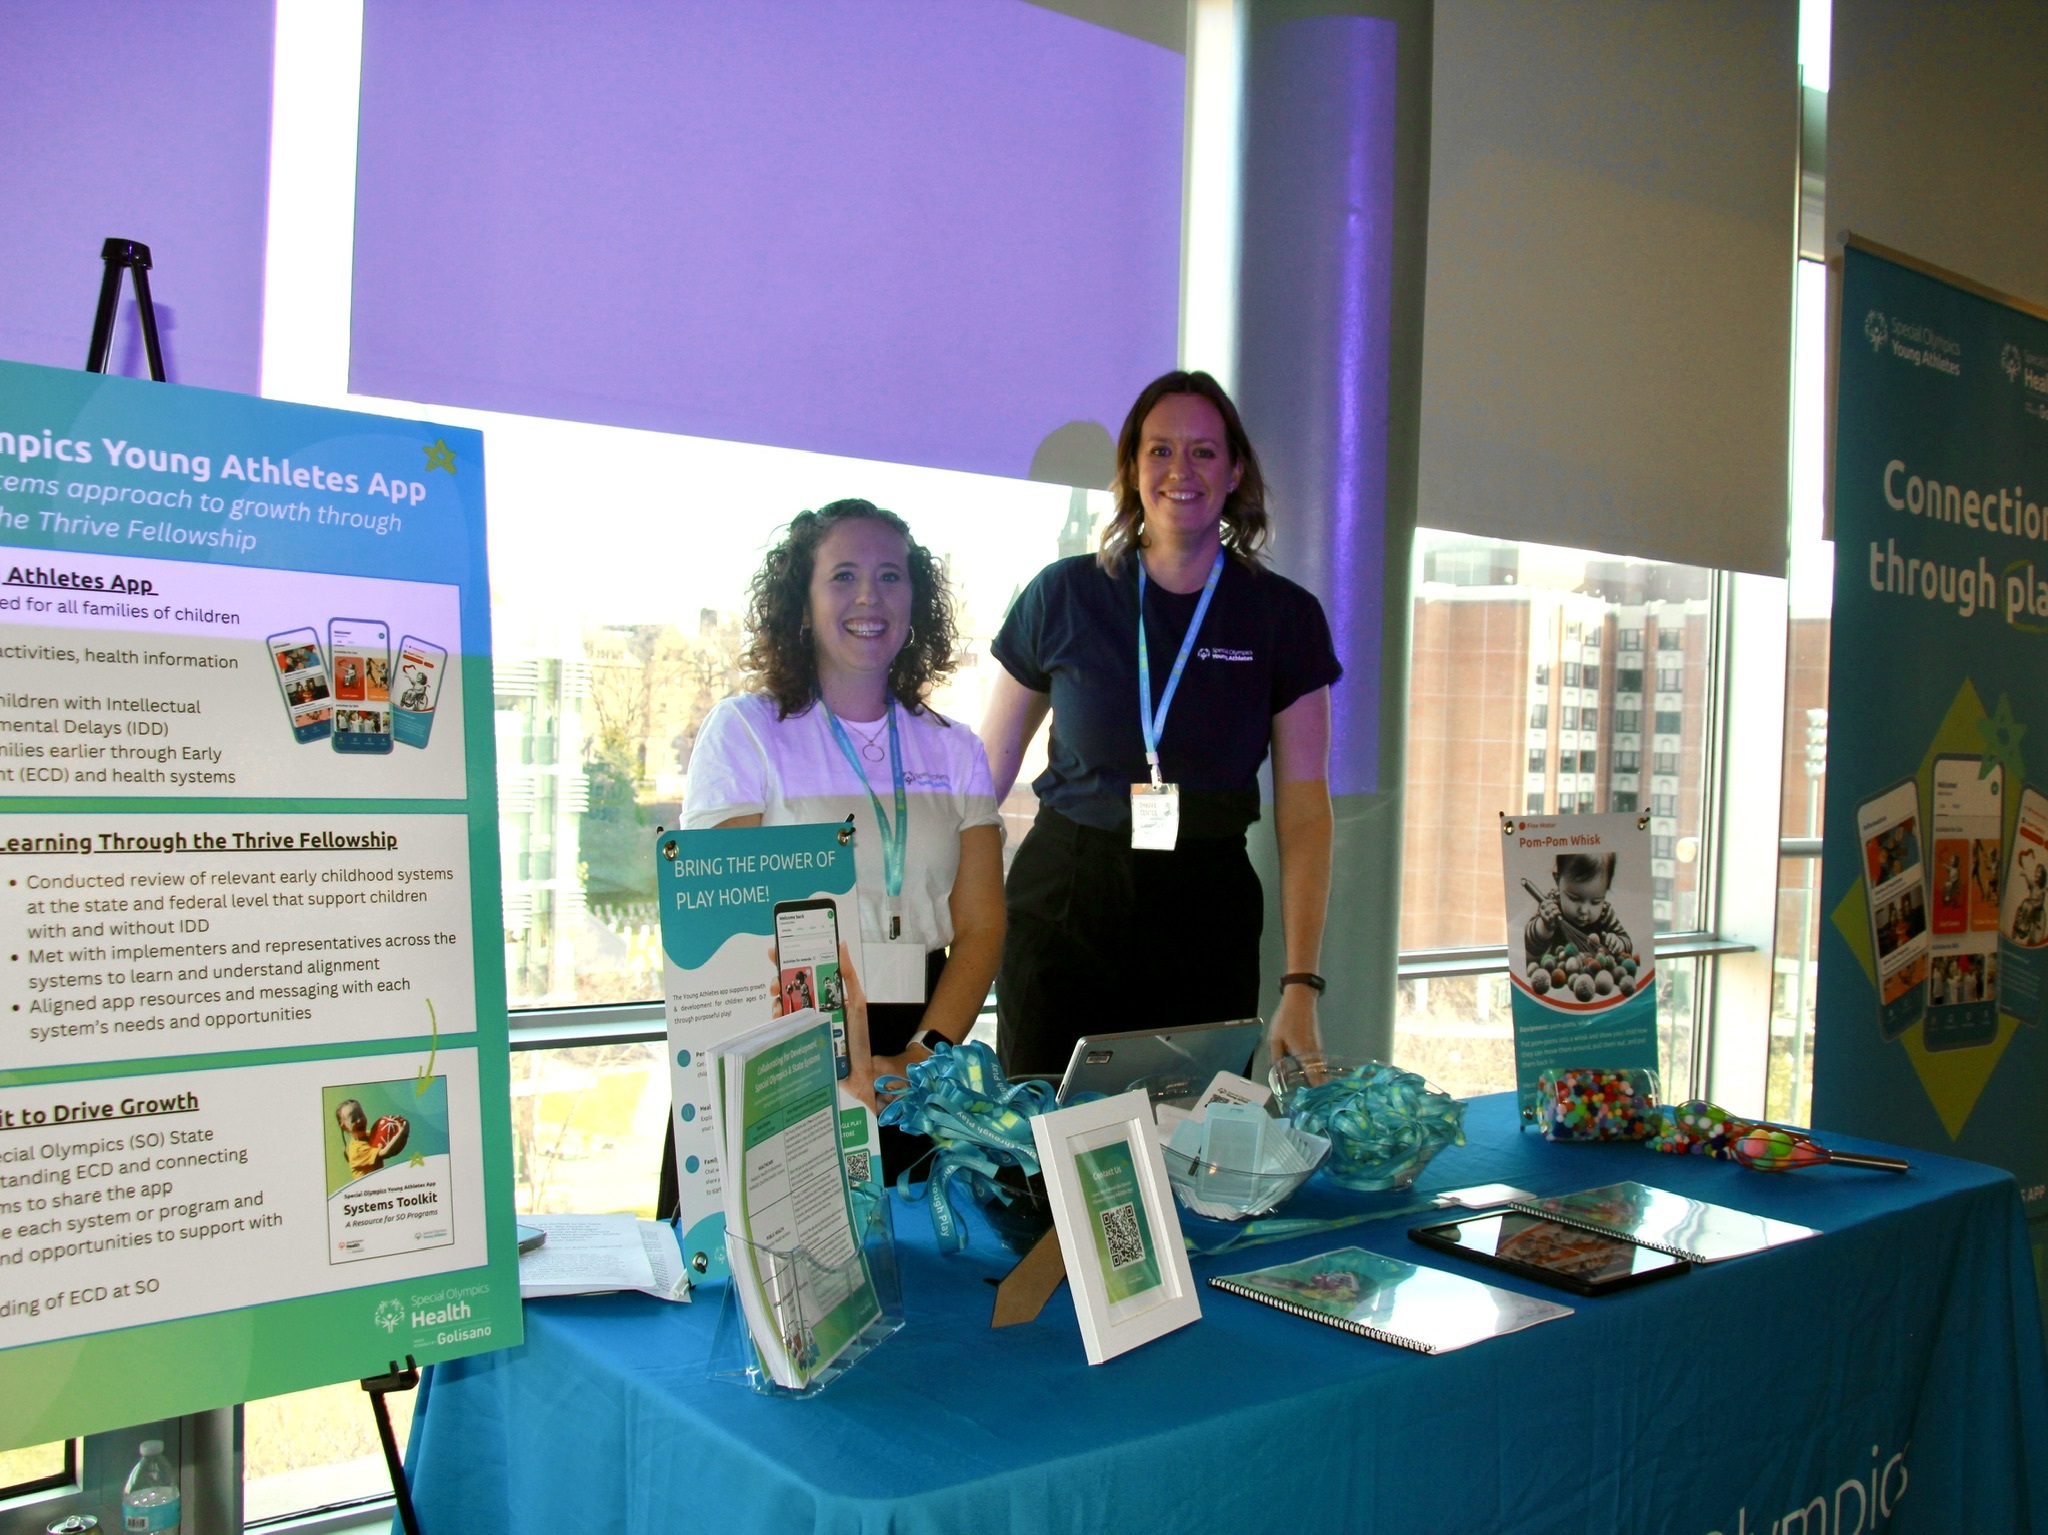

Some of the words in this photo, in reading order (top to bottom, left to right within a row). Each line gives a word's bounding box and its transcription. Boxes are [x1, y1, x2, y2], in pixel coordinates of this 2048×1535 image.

[1891, 339, 1921, 366] Young
[1922, 349, 1961, 376] Athletes
[101, 438, 212, 483] Young
[219, 453, 360, 494] Athletes
[367, 471, 427, 507] App
[66, 482, 193, 509] approach
[199, 493, 225, 514] to
[228, 498, 311, 523] growth
[317, 504, 402, 533] through
[38, 510, 121, 539] Thrive
[126, 519, 257, 554] Fellowship
[7, 566, 105, 589] Athletes
[110, 574, 153, 596] App
[1869, 538, 1996, 617] through
[24, 596, 54, 613] for
[56, 599, 79, 615] all
[81, 600, 150, 619] families
[152, 605, 172, 620] of
[173, 606, 241, 625] children
[83, 647, 139, 665] health
[142, 650, 239, 670] information
[62, 695, 102, 711] with
[105, 696, 202, 715] Intellectual
[62, 719, 123, 739] Delays
[126, 720, 169, 738] (IDD)
[48, 743, 107, 759] earlier
[109, 744, 178, 764] through
[181, 746, 223, 765] Early
[18, 766, 70, 784] (ECD)
[73, 767, 108, 783] and
[111, 767, 166, 784] health
[169, 770, 237, 787] systems
[99, 832, 187, 854] Through
[193, 831, 227, 849] the
[232, 831, 295, 849] Thrive
[300, 831, 398, 851] Fellowship
[1519, 836, 1568, 848] Pom-Pom
[1570, 833, 1601, 846] Whisk
[674, 857, 723, 878] BRING
[726, 855, 756, 874] THE
[760, 852, 813, 872] POWER
[816, 850, 836, 868] OF
[25, 872, 126, 890] Conducted
[129, 871, 186, 888] review
[188, 870, 208, 886] of
[210, 870, 277, 886] relevant
[279, 868, 318, 887] early
[320, 867, 394, 883] childhood
[397, 868, 454, 885] systems
[25, 900, 46, 915] at
[49, 898, 81, 914] the
[83, 898, 129, 913] state
[132, 895, 165, 912] and
[168, 893, 228, 910] federal
[231, 892, 270, 909] level
[271, 892, 305, 907] that
[307, 891, 367, 909] support
[369, 889, 428, 904] children
[676, 889, 715, 910] PLAY
[719, 885, 770, 906] HOME!
[26, 923, 67, 940] with
[70, 921, 105, 938] and
[108, 920, 176, 937] without
[178, 918, 210, 934] IDD
[27, 948, 65, 964] Met
[67, 945, 107, 963] with
[110, 943, 228, 963] implementers
[230, 938, 261, 955] and
[264, 934, 383, 956] representatives
[384, 934, 431, 948] across
[432, 931, 457, 946] the
[27, 973, 104, 993] systems
[106, 971, 126, 985] to
[129, 968, 174, 984] learn
[176, 964, 209, 982] and
[212, 959, 304, 980] understand
[306, 957, 381, 977] alignment
[729, 986, 749, 994] supports
[750, 983, 766, 992] growth
[28, 994, 97, 1017] Aligned
[100, 996, 136, 1013] app
[138, 991, 222, 1007] resources
[225, 985, 255, 1002] and
[258, 981, 340, 1001] messaging
[341, 979, 374, 995] with
[376, 976, 411, 993] each
[681, 1002, 712, 1012] development
[112, 1015, 166, 1034] needs
[168, 1012, 201, 1030] and
[203, 1006, 313, 1030] opportunities
[674, 1016, 694, 1025] through
[694, 1012, 720, 1022] purposeful
[0, 1109, 15, 1128] it
[22, 1108, 47, 1125] to
[54, 1101, 114, 1122] Drive
[121, 1091, 200, 1116] Growth
[38, 1137, 125, 1162] Olympics
[128, 1131, 166, 1152] (SO)
[169, 1128, 215, 1146] State
[75, 1161, 114, 1181] ECD
[117, 1156, 151, 1176] and
[154, 1147, 249, 1171] connecting
[1092, 1167, 1114, 1181] Contact
[1114, 1165, 1122, 1174] Us
[25, 1197, 48, 1212] to
[51, 1190, 103, 1209] share
[105, 1184, 137, 1202] the
[139, 1181, 174, 1200] app
[343, 1200, 394, 1217] Systems
[396, 1191, 438, 1208] Toolkit
[15, 1217, 63, 1238] each
[66, 1211, 132, 1234] system
[134, 1208, 155, 1222] or
[158, 1198, 230, 1223] program
[233, 1189, 264, 1209] and
[345, 1221, 351, 1229] A
[352, 1217, 383, 1227] Resource
[384, 1215, 395, 1224] for
[407, 1209, 439, 1219] Programs
[27, 1231, 153, 1265] opportunities
[155, 1229, 176, 1243] to
[178, 1218, 246, 1241] support
[247, 1212, 283, 1230] with
[43, 1291, 66, 1311] of
[68, 1286, 109, 1308] ECD
[111, 1283, 132, 1300] at
[133, 1277, 161, 1296] SO
[411, 1289, 444, 1308] Special
[446, 1283, 490, 1300] Olympics
[411, 1300, 471, 1329] Health
[437, 1326, 492, 1346] Golisano
